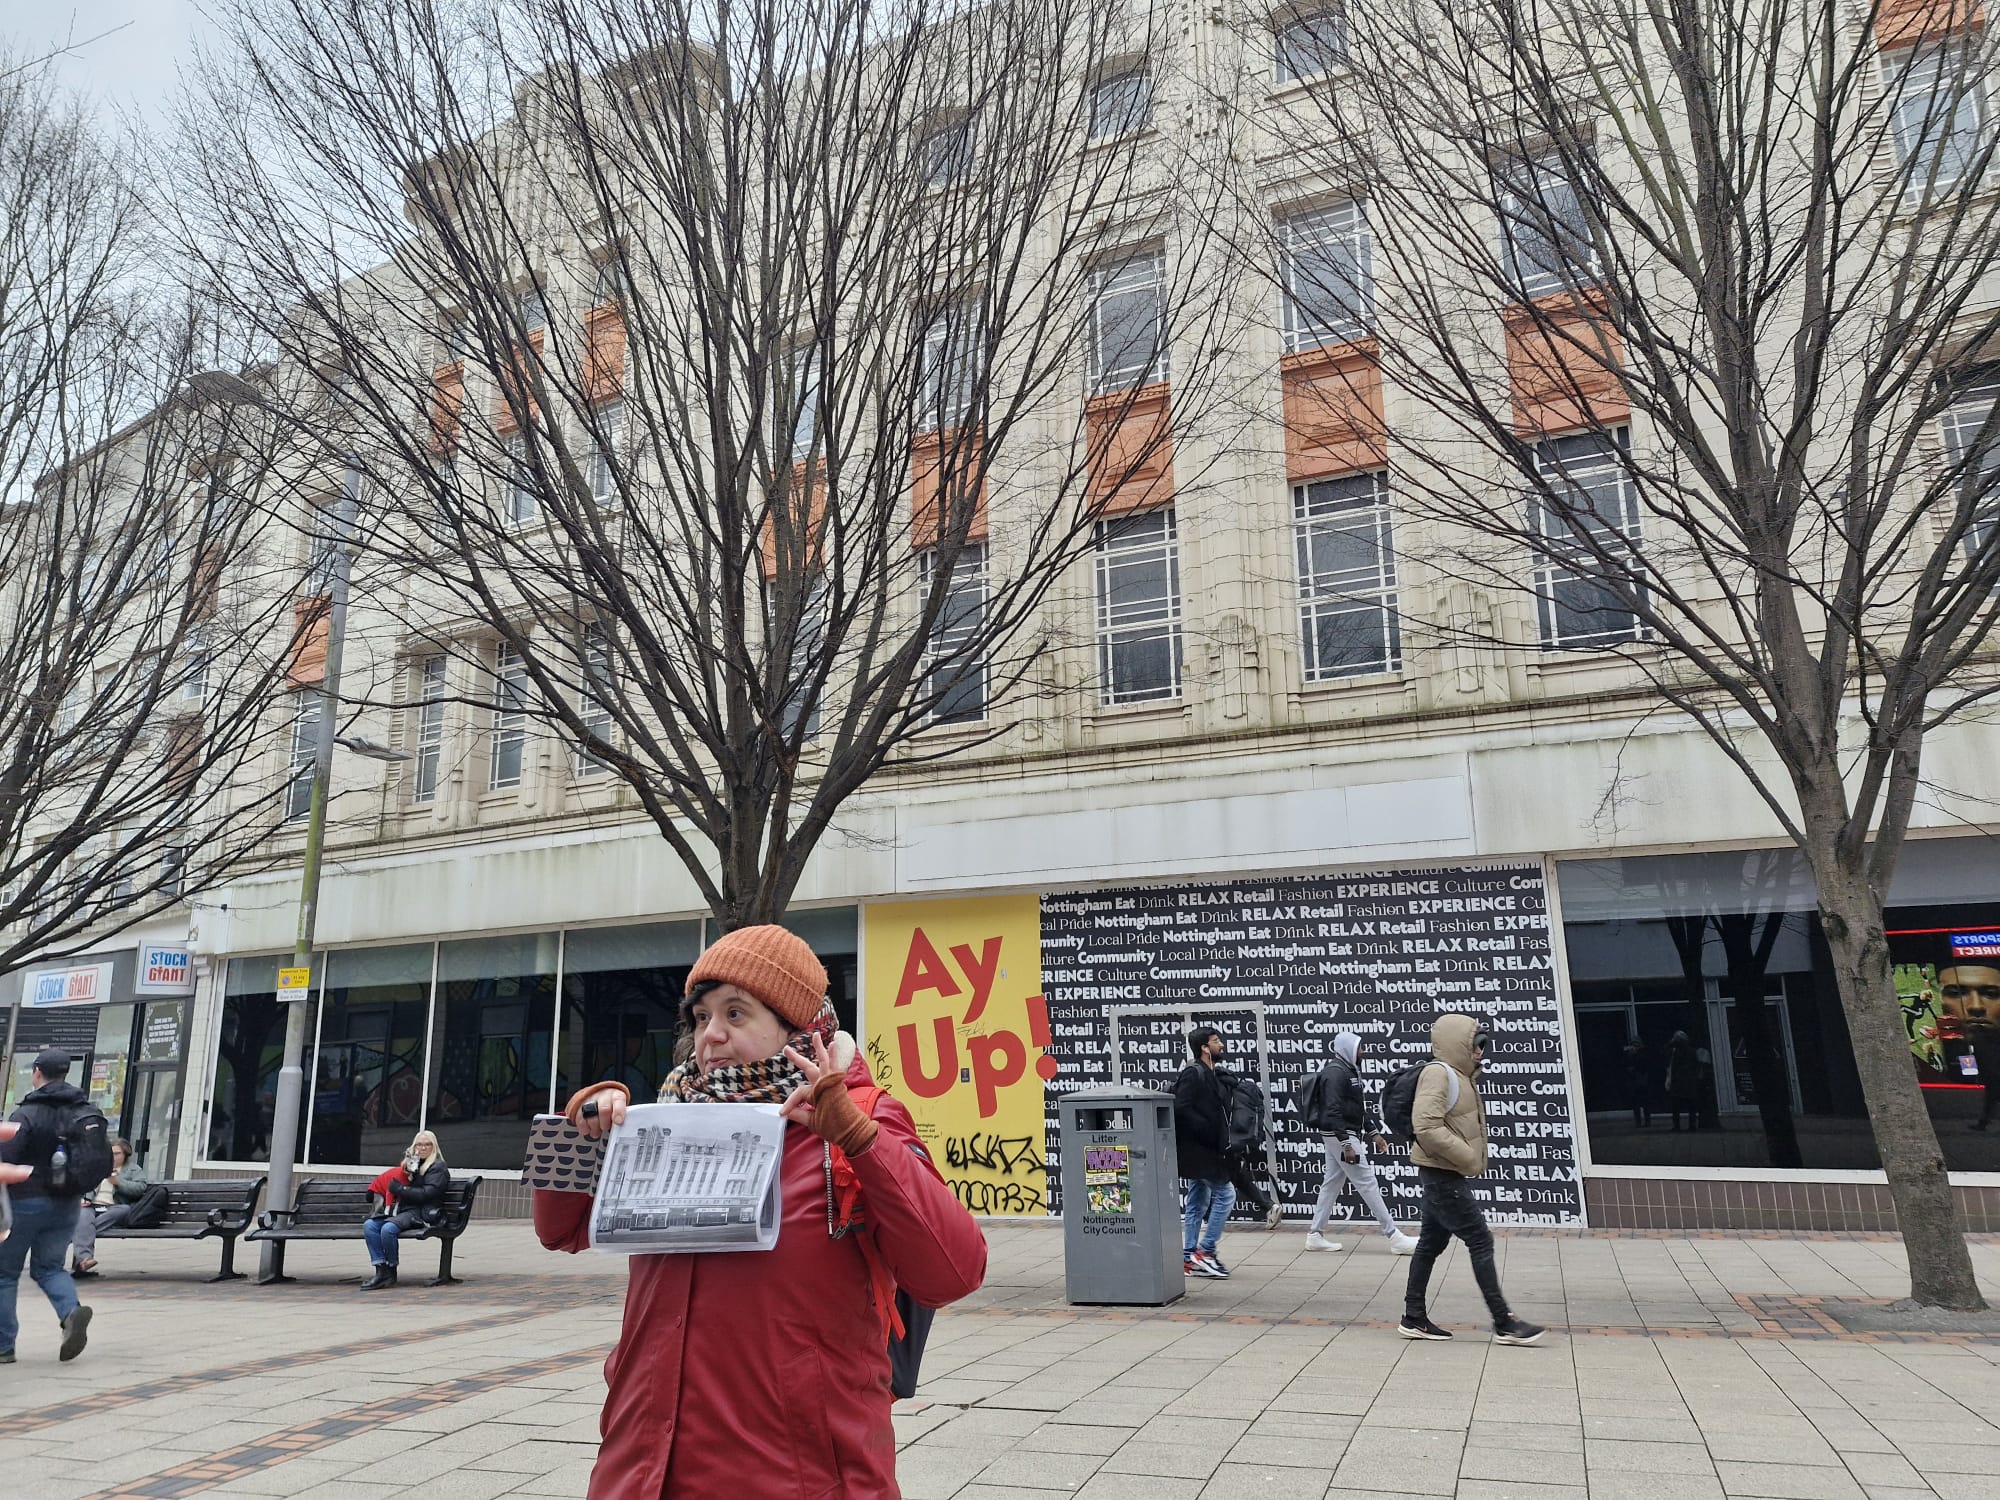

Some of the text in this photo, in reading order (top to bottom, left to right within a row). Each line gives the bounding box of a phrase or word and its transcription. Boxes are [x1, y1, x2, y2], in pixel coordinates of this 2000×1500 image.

[1039, 897, 1112, 915] Nottingham
[1115, 896, 1135, 909] Eat
[1138, 894, 1175, 908] Drink
[1178, 891, 1229, 906] RELAX
[1233, 889, 1274, 903] Retail
[1278, 886, 1333, 901] Fashion
[1337, 881, 1439, 898] EXPERIENCE
[1444, 877, 1505, 893] Culture
[1059, 916, 1091, 929] Pride
[1094, 912, 1172, 930] Nottingham
[1176, 911, 1197, 924] Eat
[1200, 909, 1238, 923] Drink
[1241, 907, 1296, 921] RELAX
[1300, 904, 1343, 919] Retail
[1347, 901, 1405, 917] Fashion
[1408, 896, 1516, 914] EXPERIENCE
[1088, 932, 1122, 946] Local
[1126, 931, 1160, 944] Pride
[1163, 927, 1245, 945] Nottingham
[1248, 926, 1270, 940] Eat
[1274, 924, 1314, 939] Drink
[1318, 922, 1375, 937] RELAX
[1379, 920, 1425, 935] Retail
[1429, 917, 1489, 933] Fashion
[151, 952, 188, 966] STOCK
[1077, 949, 1155, 966] Community
[1159, 948, 1195, 961] Local
[1199, 946, 1234, 960] Pride
[1237, 943, 1324, 961] Nottingham
[1328, 942, 1352, 956] Eat
[1356, 940, 1398, 955] Drink
[1402, 938, 1463, 953] RELAX
[1467, 936, 1515, 951] Retail
[149, 967, 185, 981] GIANT
[894, 927, 1004, 1024] Ay
[1098, 968, 1146, 981] Culture
[1150, 965, 1231, 982] Community
[1235, 964, 1273, 978] Local
[1277, 962, 1315, 976] Pride
[1319, 959, 1411, 978] Nottingham
[1414, 958, 1440, 973] Eat
[1444, 957, 1489, 972] Drink
[1492, 955, 1553, 970] RELAX
[39, 974, 93, 1000] STOCK GIANT
[1055, 986, 1140, 1001] EXPERIENCE
[1145, 985, 1196, 999] Culture
[1199, 982, 1284, 1000] Community
[1288, 981, 1328, 995] Local
[1332, 980, 1371, 994] Pride
[1374, 977, 1471, 996] Nottingham
[1474, 977, 1501, 991] Eat
[1505, 975, 1552, 990] Drink
[1050, 1005, 1098, 1019] Fashion
[1252, 1000, 1339, 1018] ommunity
[1343, 999, 1385, 1014] Local
[1389, 998, 1430, 1013] Pride
[1433, 996, 1533, 1015] Nottingham
[1055, 1024, 1092, 1037] Retail
[1096, 1023, 1147, 1036] Fahion
[1150, 1022, 1240, 1036] EXPNCE
[1245, 1020, 1300, 1034] Clture
[1303, 1019, 1396, 1037] Community
[1128, 1041, 1169, 1054] Retail
[1226, 1040, 1323, 1054] EXPRIENCE
[1491, 1037, 1537, 1052] Local
[897, 994, 1057, 1118] Up!
[1083, 1060, 1103, 1073] Eat
[1148, 1060, 1187, 1073] RELA
[1306, 1059, 1410, 1073] EXIENC
[1476, 1079, 1527, 1094] ulture
[1092, 1135, 1117, 1143] Litter
[1486, 1142, 1537, 1158] Retail
[1249, 1158, 1287, 1173] Loal
[1513, 1164, 1576, 1180] RELAX
[1495, 1185, 1523, 1200] Eat
[1527, 1186, 1575, 1202] Drink
[1083, 1216, 1135, 1225] Nottingham
[1083, 1226, 1136, 1236] City Council
